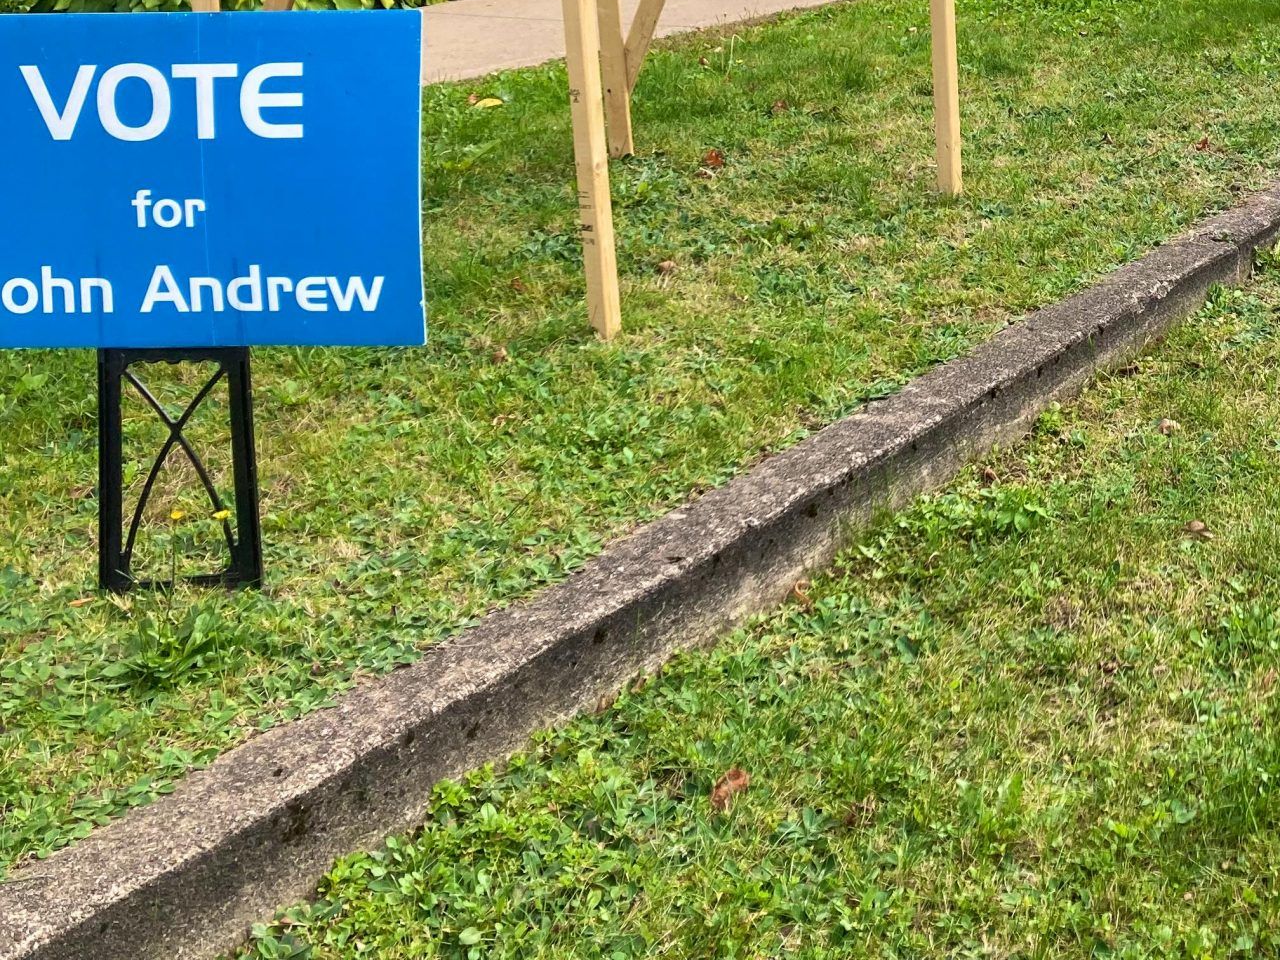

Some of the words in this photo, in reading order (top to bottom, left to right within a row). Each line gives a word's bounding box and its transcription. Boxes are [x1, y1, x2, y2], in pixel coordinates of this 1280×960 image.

[18, 62, 304, 142] VOTE
[131, 189, 206, 228] for
[0, 265, 114, 314] ohn
[140, 264, 385, 313] Andrew
